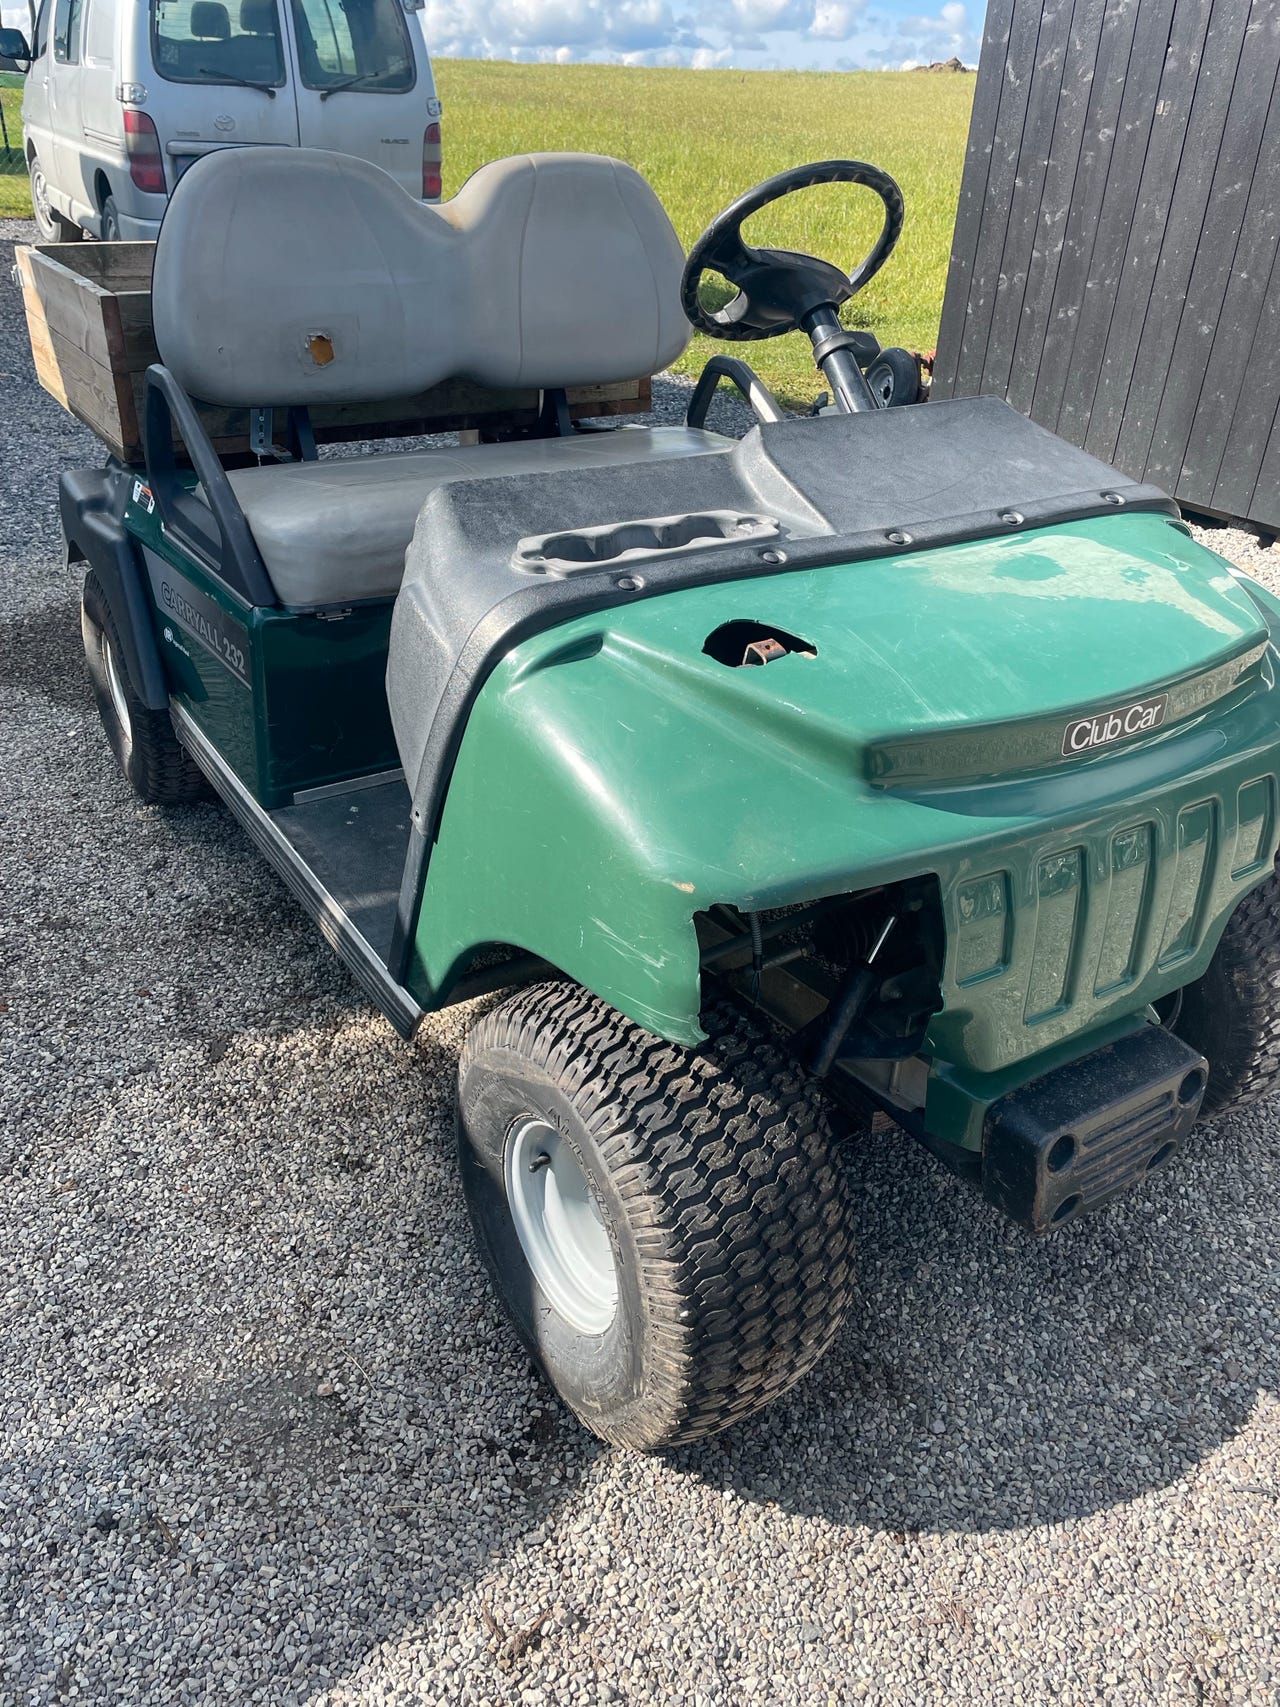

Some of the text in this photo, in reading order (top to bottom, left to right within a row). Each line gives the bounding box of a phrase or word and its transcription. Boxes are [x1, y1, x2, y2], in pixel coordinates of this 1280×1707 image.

[161, 581, 246, 675] CARRYALL 232
[1070, 704, 1162, 750] Club Car
